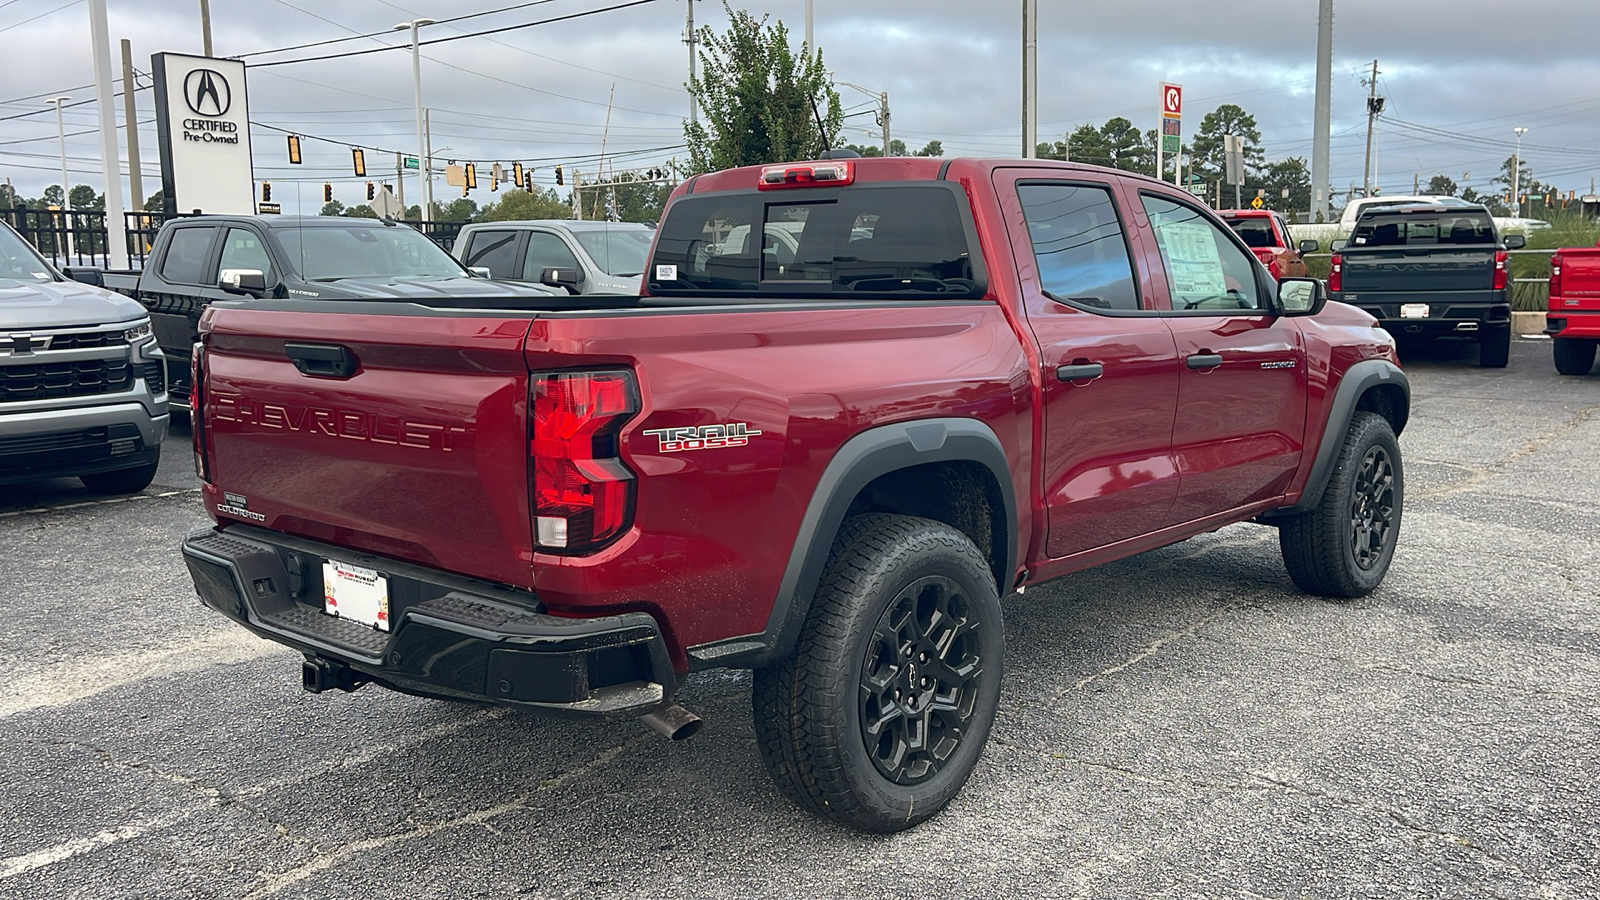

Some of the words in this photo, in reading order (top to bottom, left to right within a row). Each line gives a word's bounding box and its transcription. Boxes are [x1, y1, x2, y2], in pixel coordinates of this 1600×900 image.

[1170, 93, 1177, 108] K
[183, 118, 237, 133] CERTIFIED
[183, 131, 239, 144] Pre-Owned
[214, 395, 467, 452] CHEVROLET
[643, 422, 762, 442] TRAIL
[659, 434, 748, 453] BOSS
[217, 503, 266, 522] COLORADO
